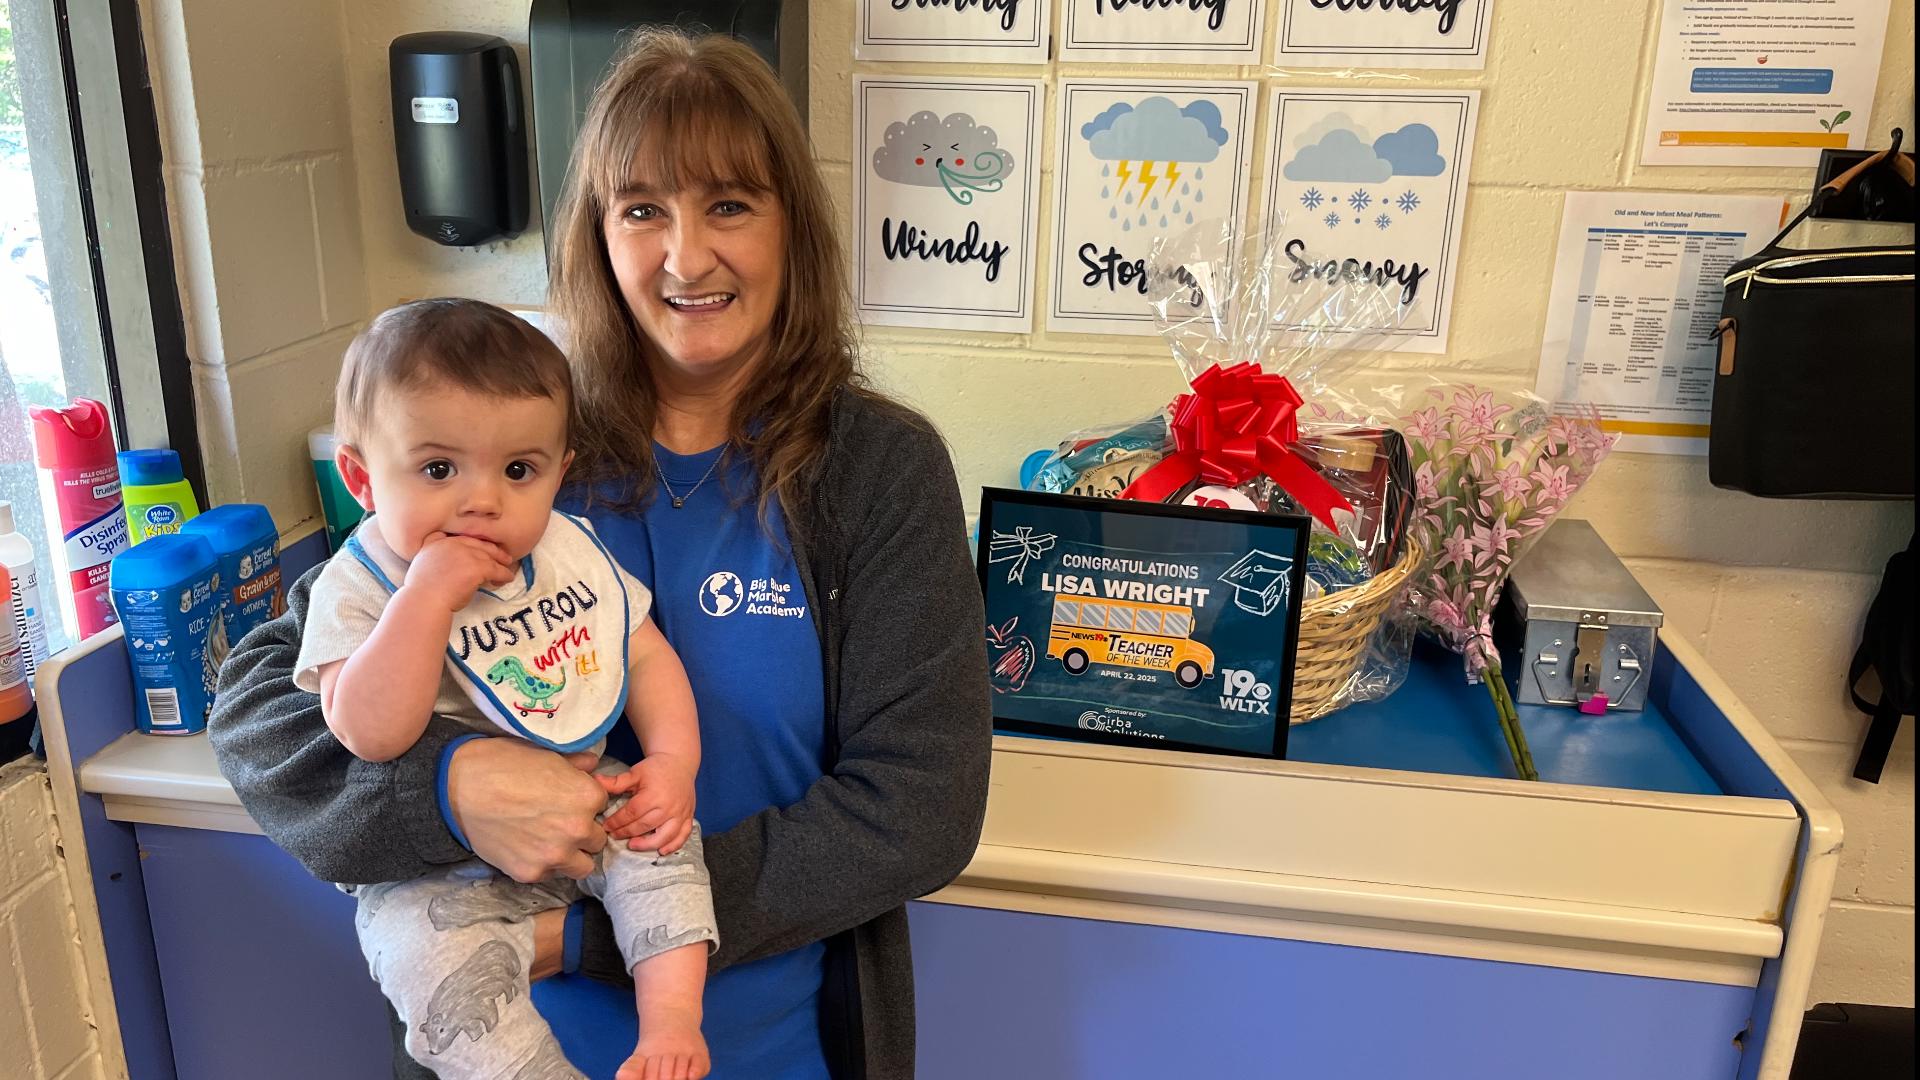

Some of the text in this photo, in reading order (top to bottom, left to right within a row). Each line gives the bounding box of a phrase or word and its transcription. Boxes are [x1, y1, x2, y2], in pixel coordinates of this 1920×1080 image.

[1694, 211, 1722, 219] Patterns:
[1660, 221, 1689, 229] Compare
[882, 217, 1009, 282] Windy
[1285, 238, 1429, 305] Snowy
[150, 509, 171, 518] White
[97, 529, 128, 555] Spray
[254, 546, 272, 564] Cereal
[88, 565, 107, 577] KILLS
[1062, 553, 1199, 580] CONGRATULATIONS
[239, 580, 264, 600] Grain
[749, 577, 791, 593] Big Blue
[1041, 572, 1210, 608] LISA WRIGHT
[747, 590, 786, 605] Marble
[242, 599, 268, 616] OATMEAL
[745, 602, 805, 619] Academy
[188, 617, 205, 636] RICE
[457, 607, 536, 660] JUST
[533, 625, 591, 672] with
[575, 650, 600, 677] it!
[1106, 652, 1172, 669] OF THE WEEK
[1101, 670, 1157, 683] APRIL 22, 2025
[1221, 668, 1251, 698] 19
[1105, 707, 1137, 717] Sponsored
[1220, 696, 1270, 716] WLTX
[1097, 715, 1132, 729] Cirba
